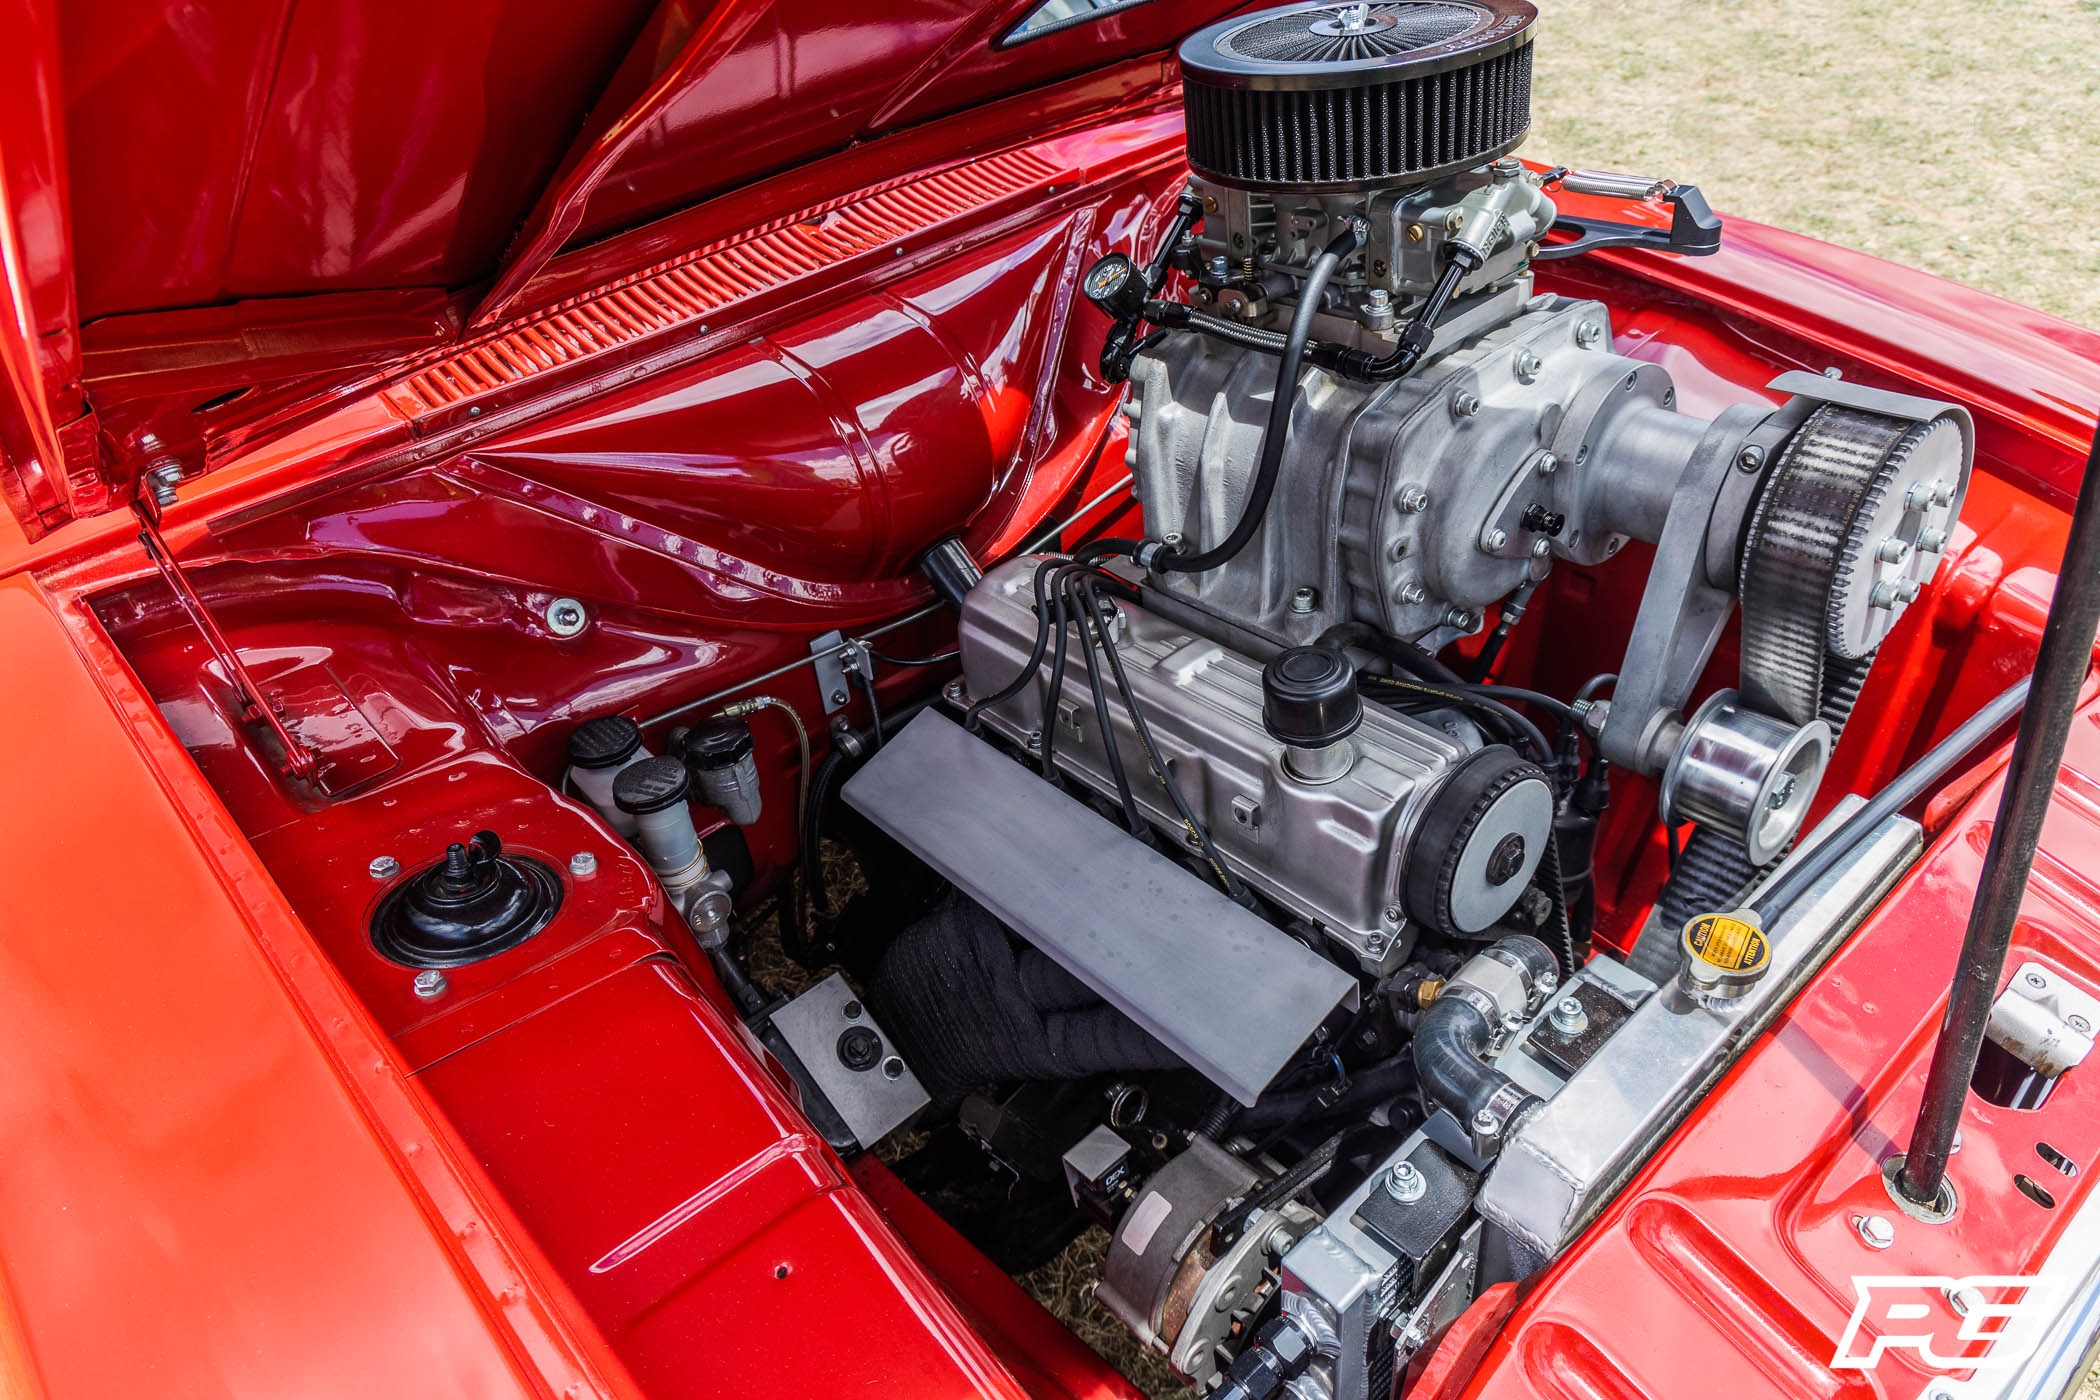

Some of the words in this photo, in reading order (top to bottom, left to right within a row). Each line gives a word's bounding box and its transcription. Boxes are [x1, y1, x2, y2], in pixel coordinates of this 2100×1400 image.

[1183, 818, 1199, 839] BOSCH
[1693, 922, 1711, 947] CAUTION
[1743, 937, 1761, 966] ATTENTION
